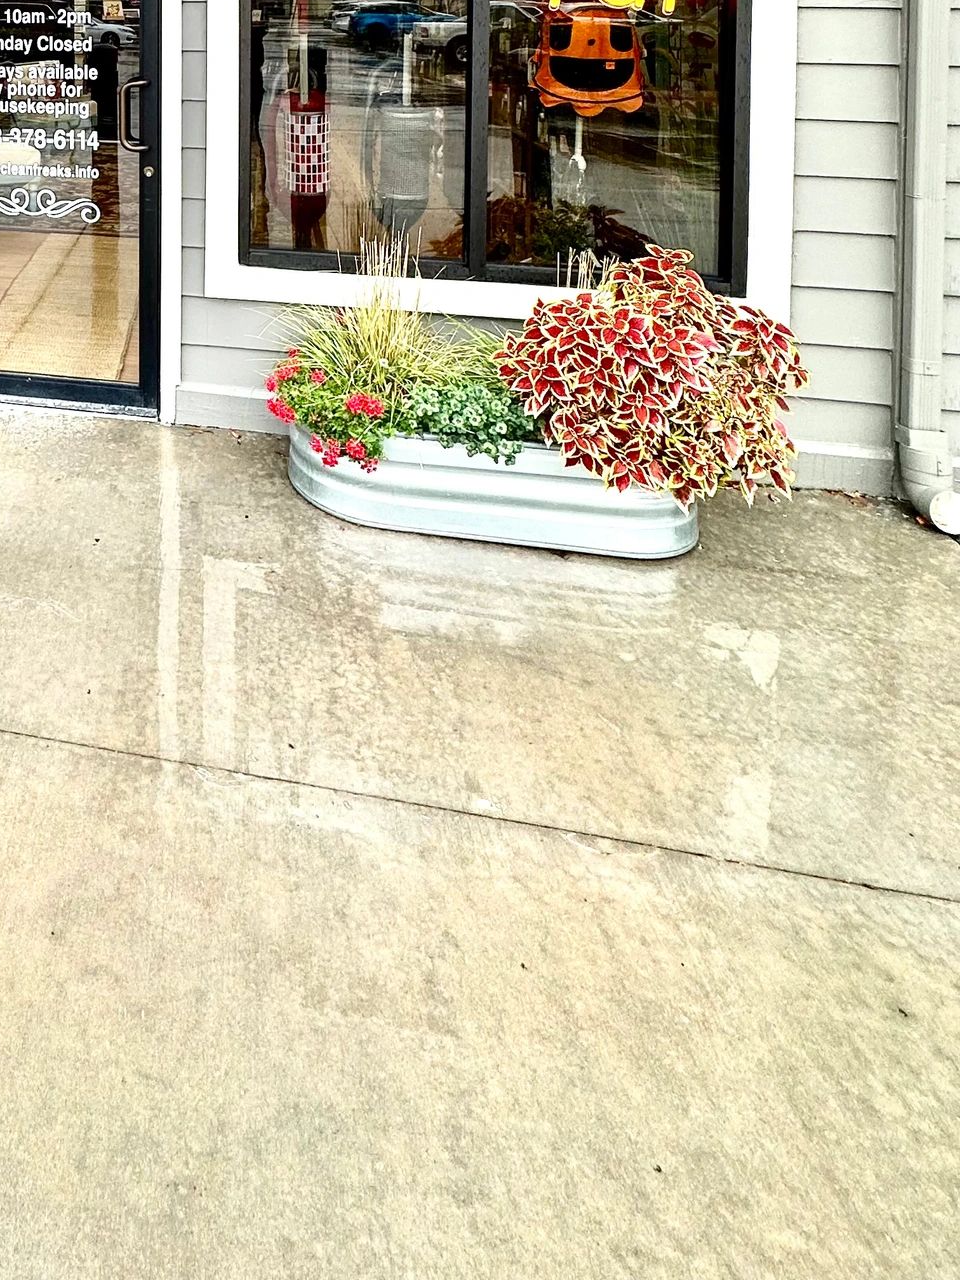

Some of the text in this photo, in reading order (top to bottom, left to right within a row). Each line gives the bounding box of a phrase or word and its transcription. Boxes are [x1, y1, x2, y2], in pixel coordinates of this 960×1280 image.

[4, 8, 45, 24] 10am
[57, 8, 92, 28] 2pm
[37, 35, 93, 52] Closed
[28, 64, 98, 80] available
[7, 81, 56, 99] phone
[60, 82, 83, 97] for
